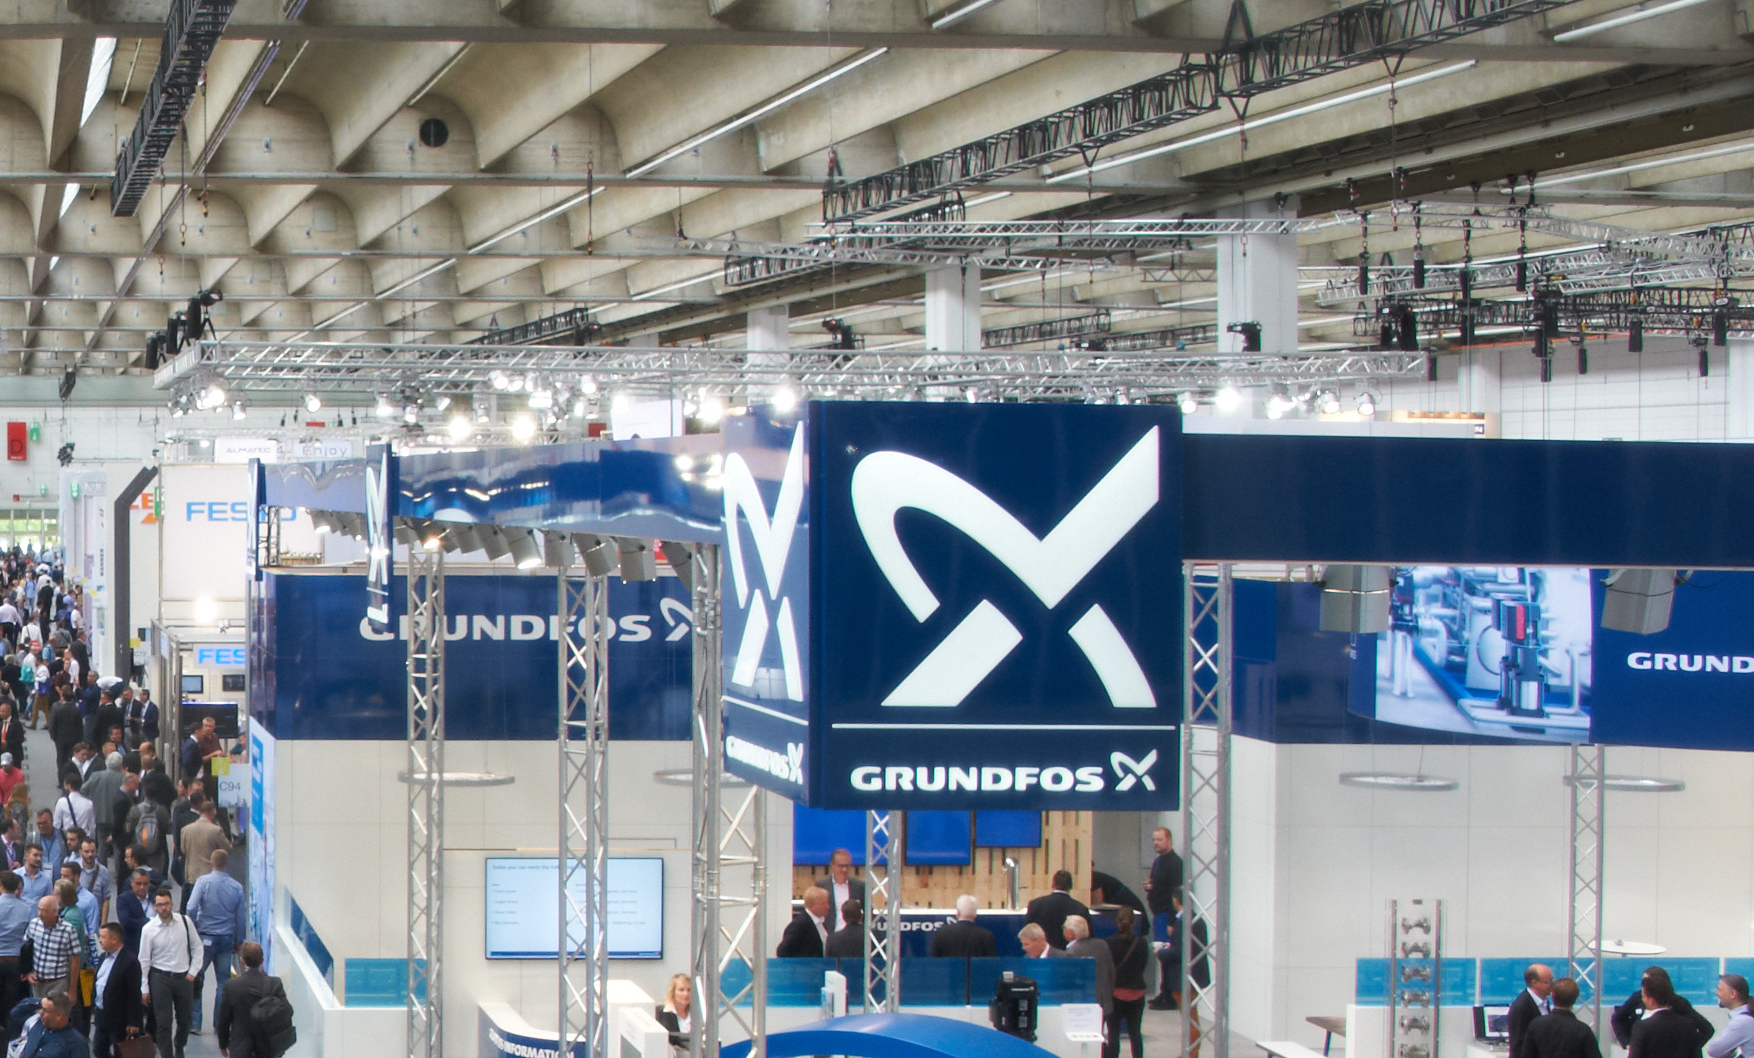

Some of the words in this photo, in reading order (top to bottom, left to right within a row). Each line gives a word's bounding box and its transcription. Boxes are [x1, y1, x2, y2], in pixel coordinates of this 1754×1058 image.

[10, 440, 24, 454] D
[186, 501, 297, 522] FESO
[198, 648, 246, 665] FES
[219, 781, 242, 792] C94
[850, 766, 1105, 793] GRUNDFOS
